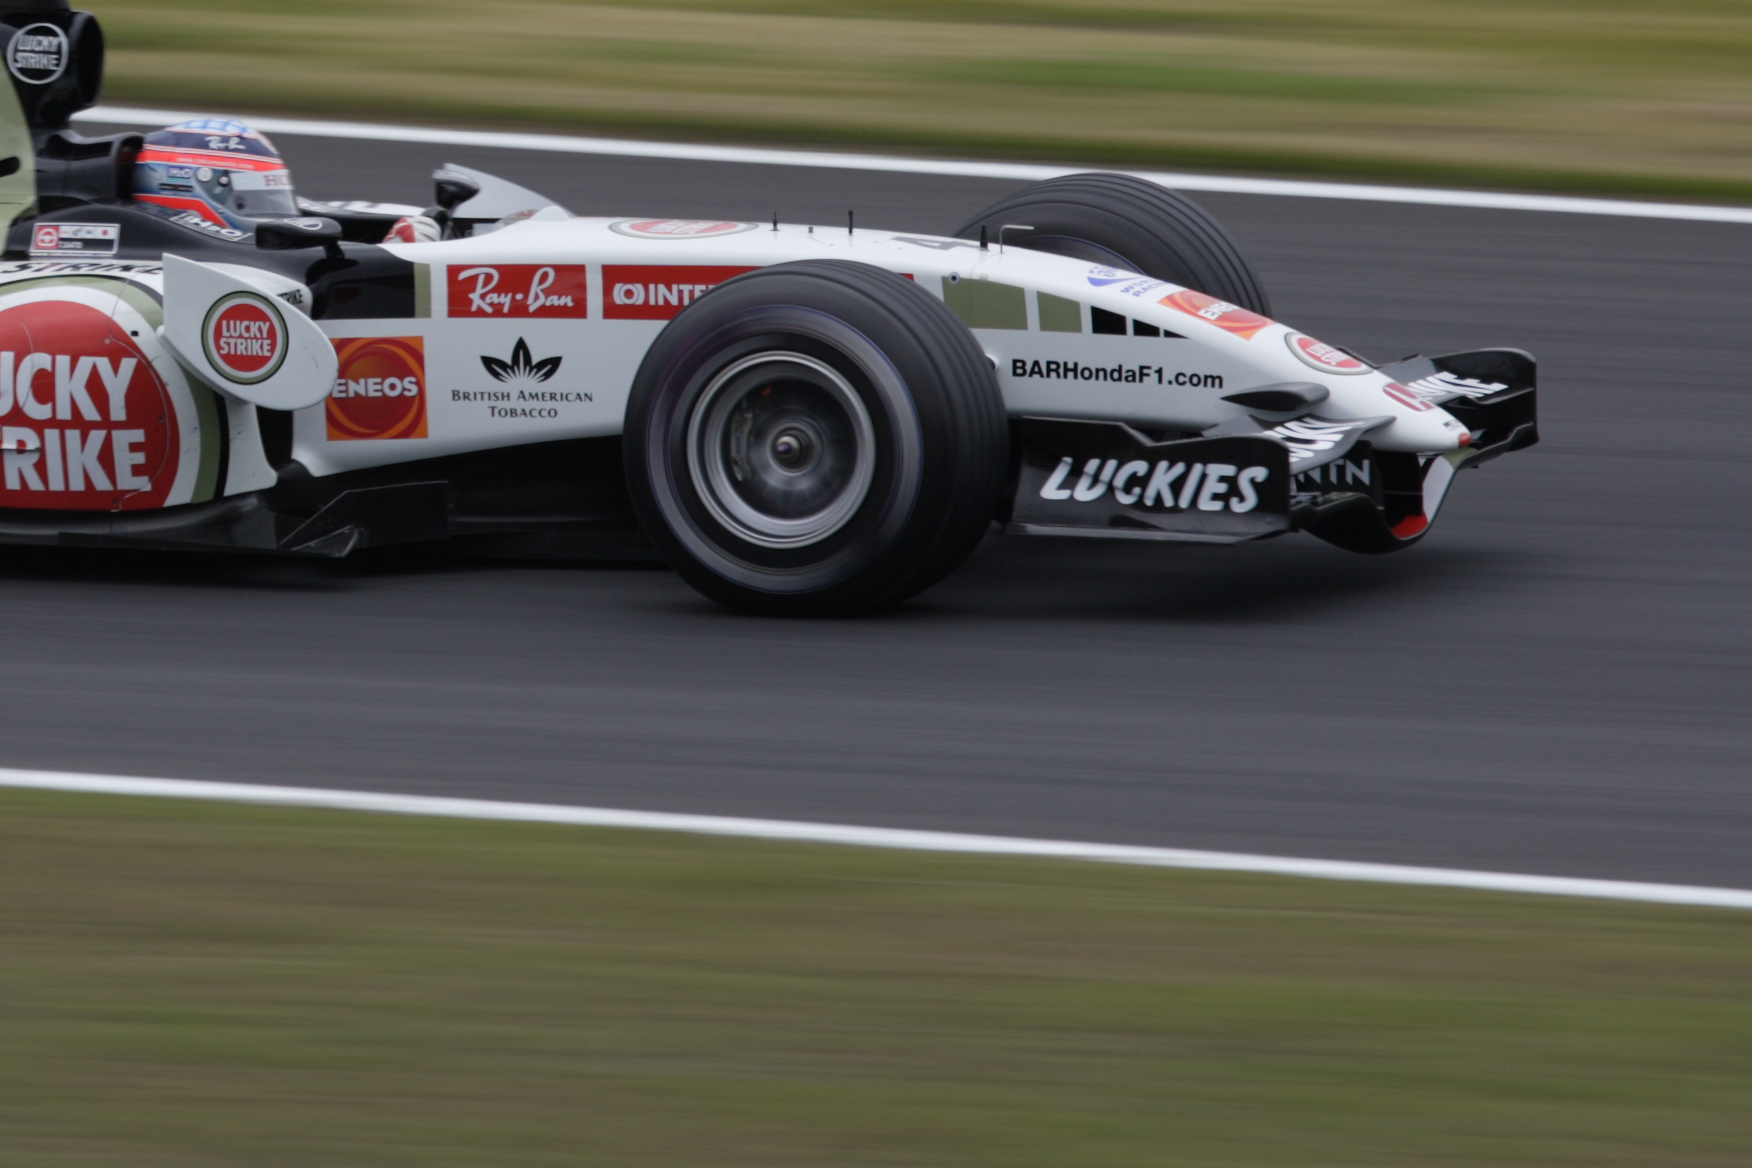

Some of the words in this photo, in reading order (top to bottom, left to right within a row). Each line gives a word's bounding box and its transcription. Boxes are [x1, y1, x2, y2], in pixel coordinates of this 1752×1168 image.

[16, 35, 61, 53] LUCKY
[13, 53, 61, 71] STRIKE
[0, 262, 162, 275] STRIKE
[648, 283, 718, 306] INTE
[221, 320, 270, 338] LUCKY
[219, 338, 271, 356] STRIKE
[1011, 358, 1224, 390] BARHondaF1.com
[331, 376, 419, 398] ENEOS
[451, 389, 511, 403] BRITISH
[516, 389, 594, 403] AMERICAN
[489, 405, 558, 419] TOBACCO
[1040, 457, 1269, 514] LUCKIES
